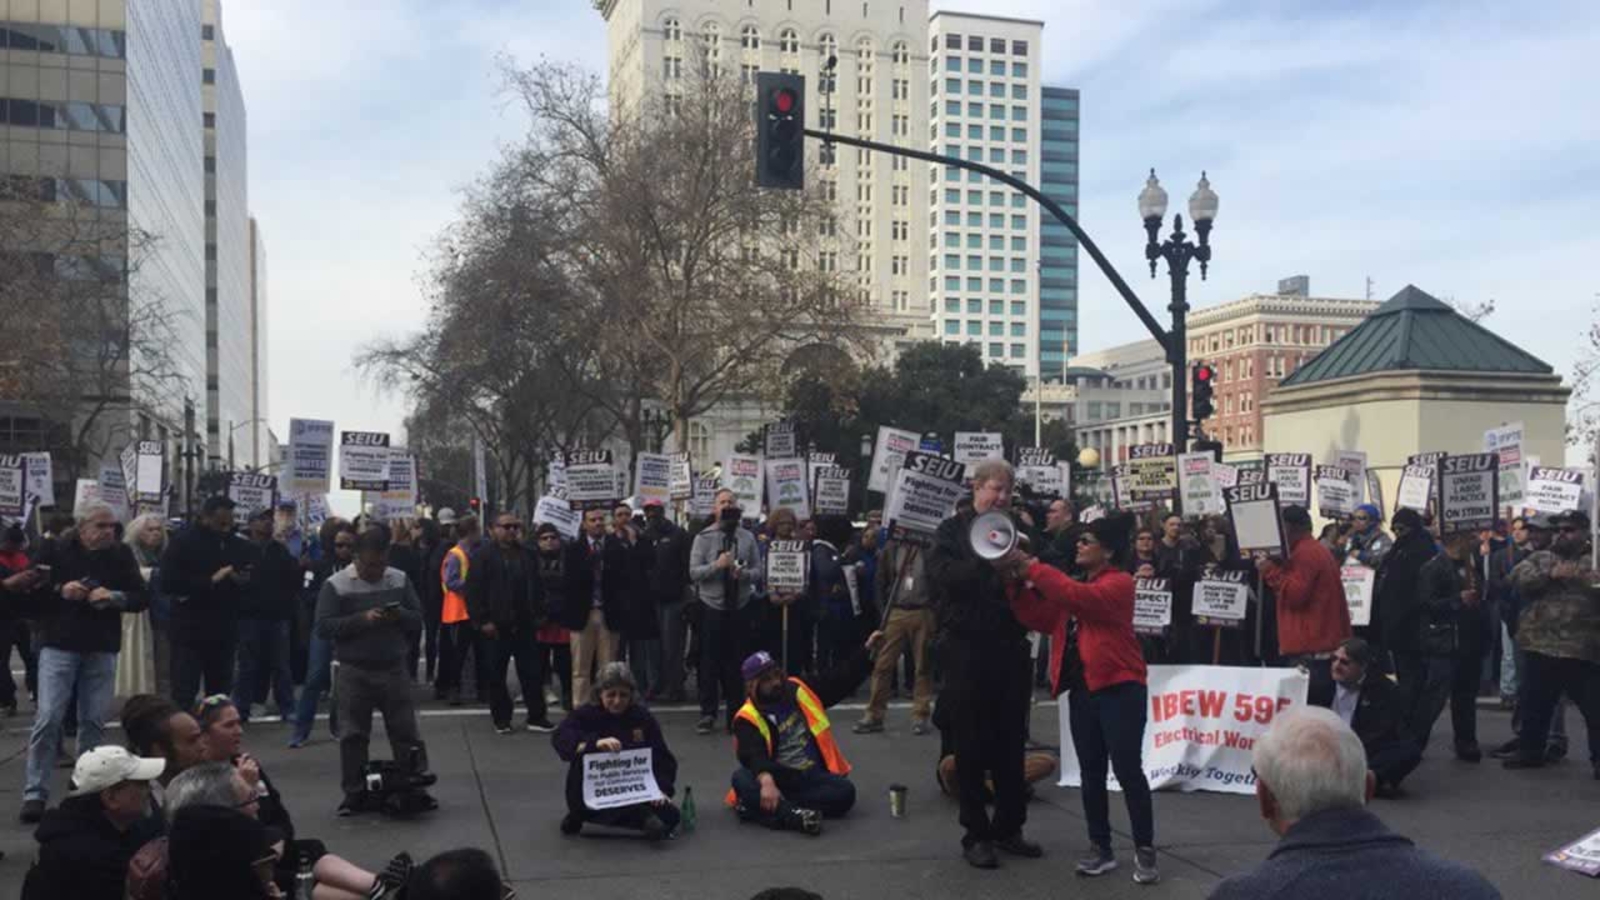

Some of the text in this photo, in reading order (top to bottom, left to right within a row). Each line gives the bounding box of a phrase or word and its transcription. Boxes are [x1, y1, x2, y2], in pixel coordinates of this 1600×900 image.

[346, 432, 384, 446] SEIU
[139, 441, 162, 454] SEIU
[1131, 444, 1170, 459] SEIU
[569, 450, 607, 464] SEIU
[809, 452, 836, 463] SEIU
[1019, 454, 1054, 466] SEIU
[1269, 453, 1307, 466] SEIU
[1444, 455, 1492, 472] SEIU
[818, 467, 850, 479] SEIU
[910, 453, 961, 481] SEIU
[1319, 466, 1346, 479] SEIU
[1405, 465, 1432, 477] SEIU
[230, 473, 272, 488] SEIU
[1241, 469, 1265, 482] SEI
[1535, 467, 1579, 482] SEIU
[904, 476, 959, 498] Fighting for
[1229, 482, 1272, 502] SEIU
[1525, 492, 1576, 501] CONTRACT
[903, 502, 944, 519] DESERVES
[1445, 506, 1491, 519] ON STRIKE
[768, 540, 804, 553] SEIU
[1202, 568, 1243, 582] SEIU
[1136, 578, 1166, 591] EIU
[1136, 593, 1169, 602] SPECT
[1151, 689, 1227, 722] IBEW
[1154, 727, 1256, 750] Electrical Wor
[589, 755, 647, 770] Fighting for
[594, 784, 647, 797] DESERVES
